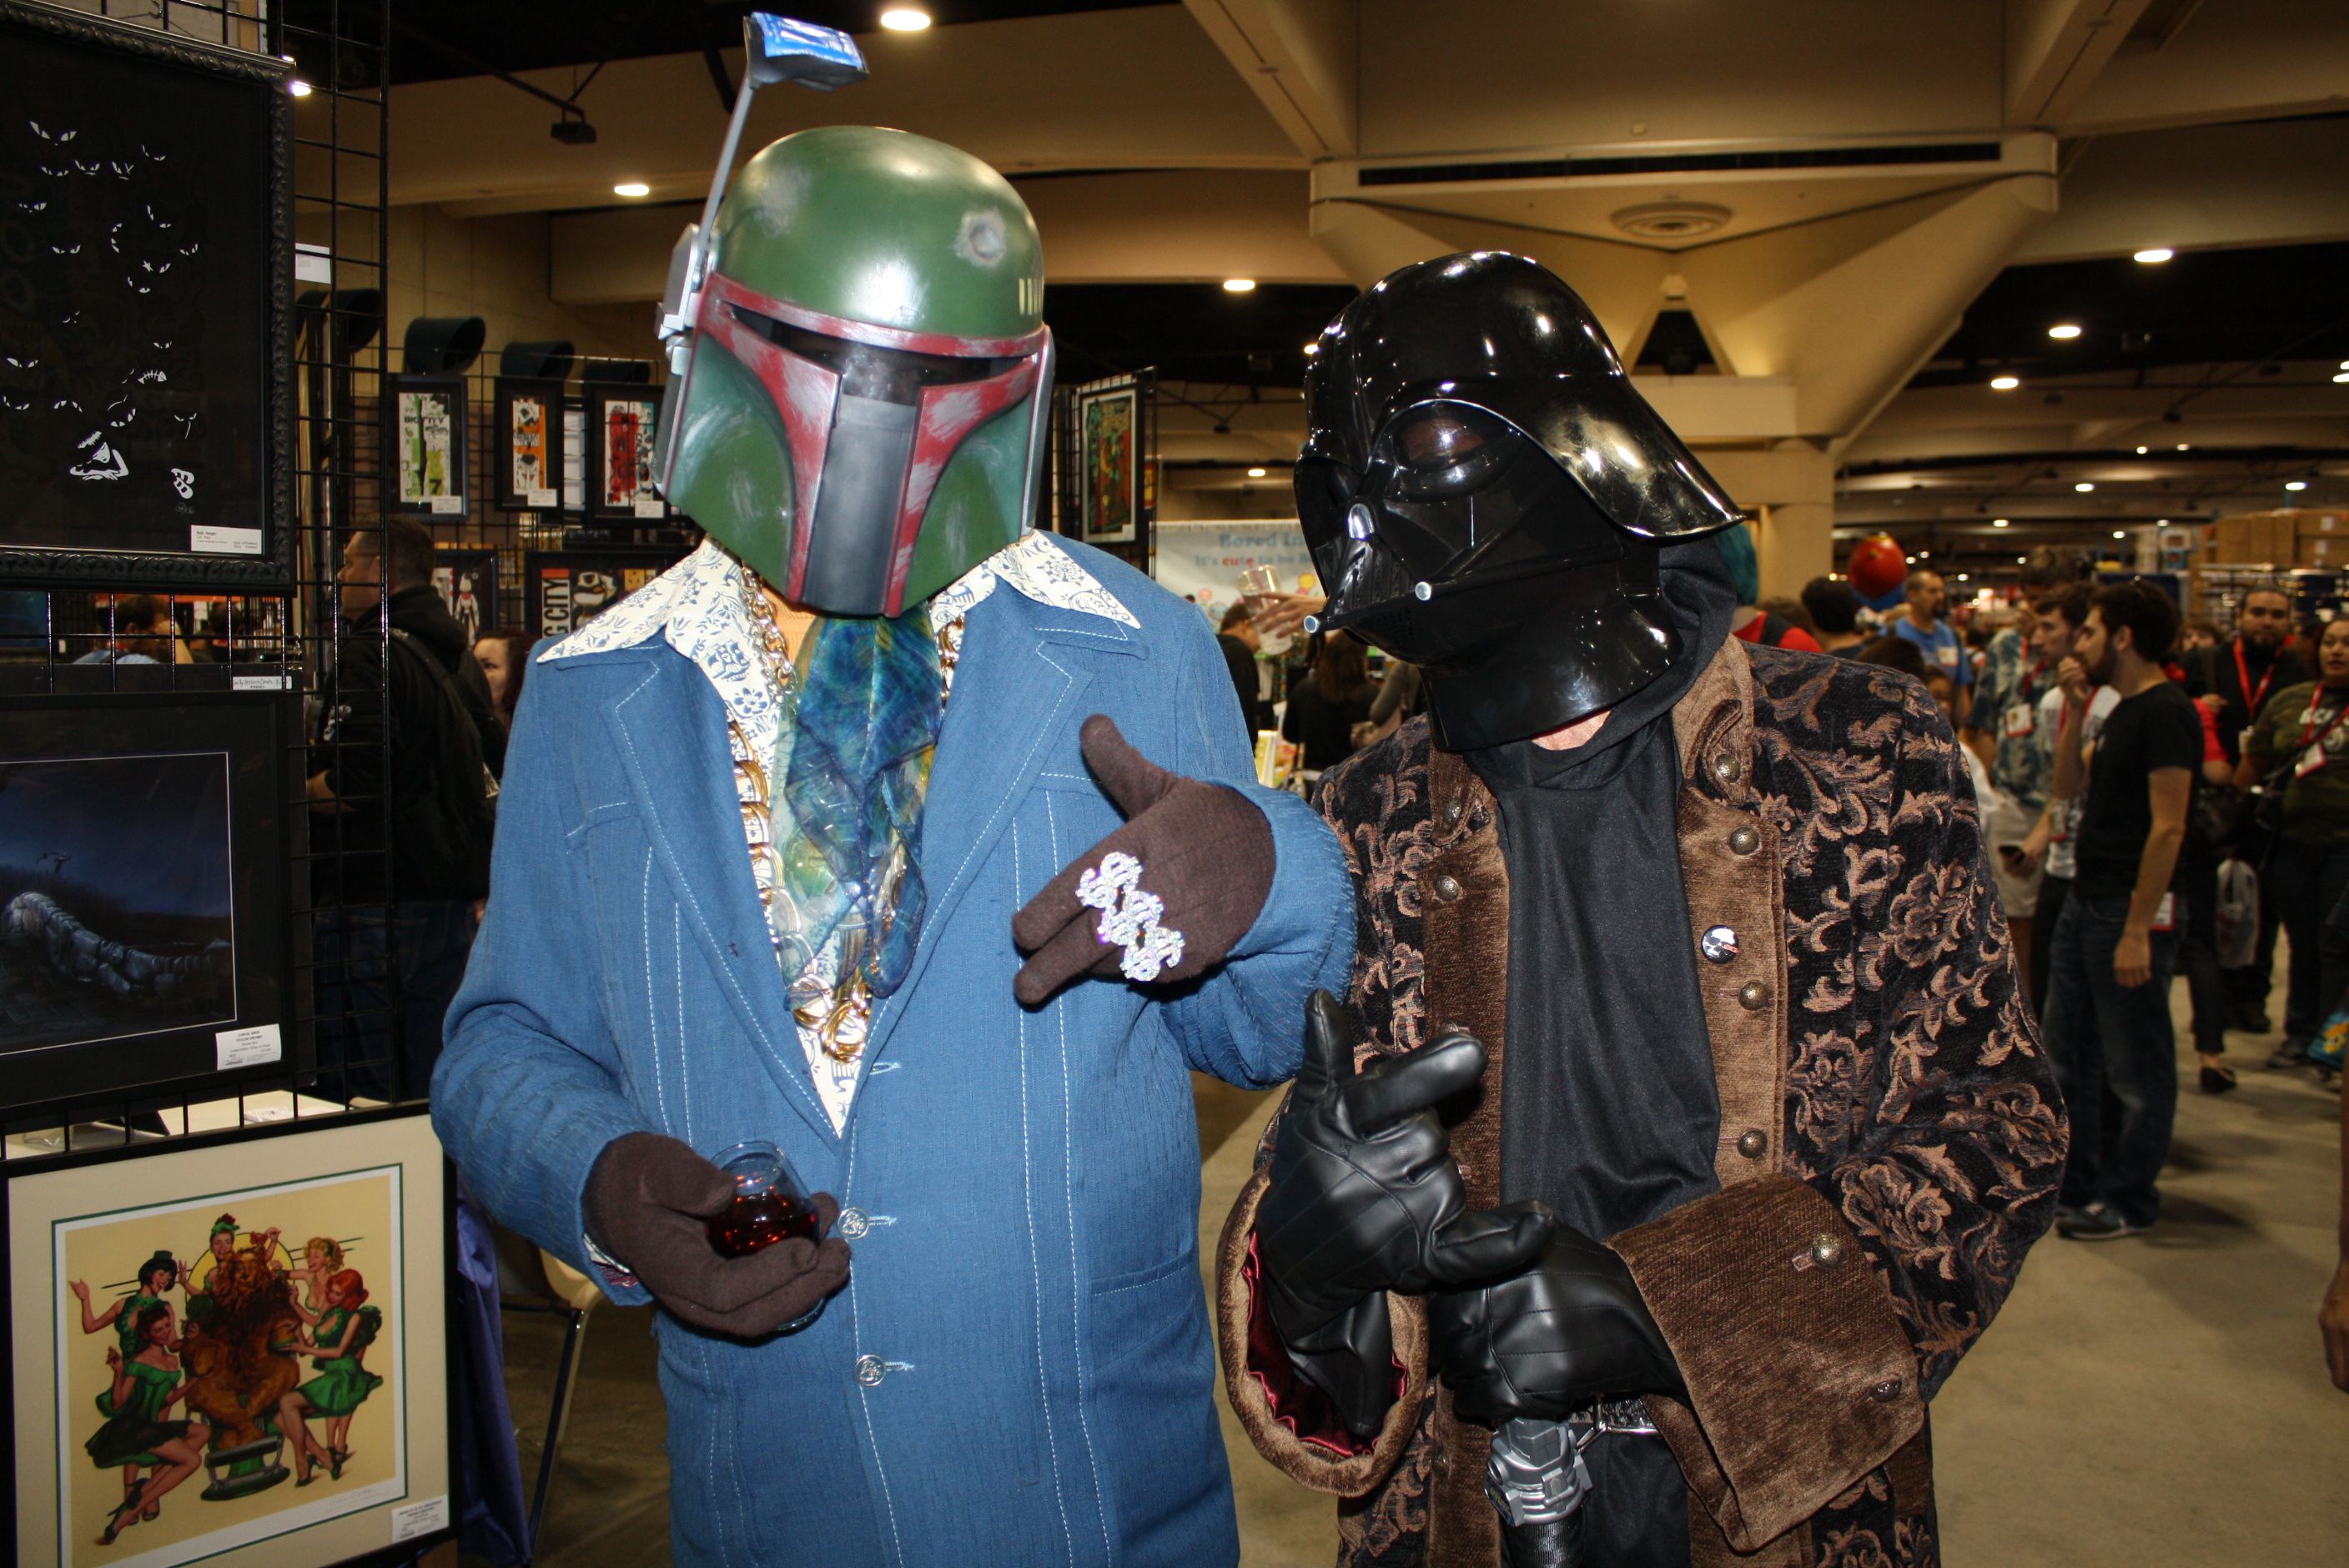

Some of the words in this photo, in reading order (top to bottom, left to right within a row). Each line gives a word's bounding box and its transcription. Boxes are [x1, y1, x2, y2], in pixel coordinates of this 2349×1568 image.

[1219, 532, 1277, 547] Bored
[1222, 555, 1255, 567] cute
[543, 579, 569, 621] CITY
